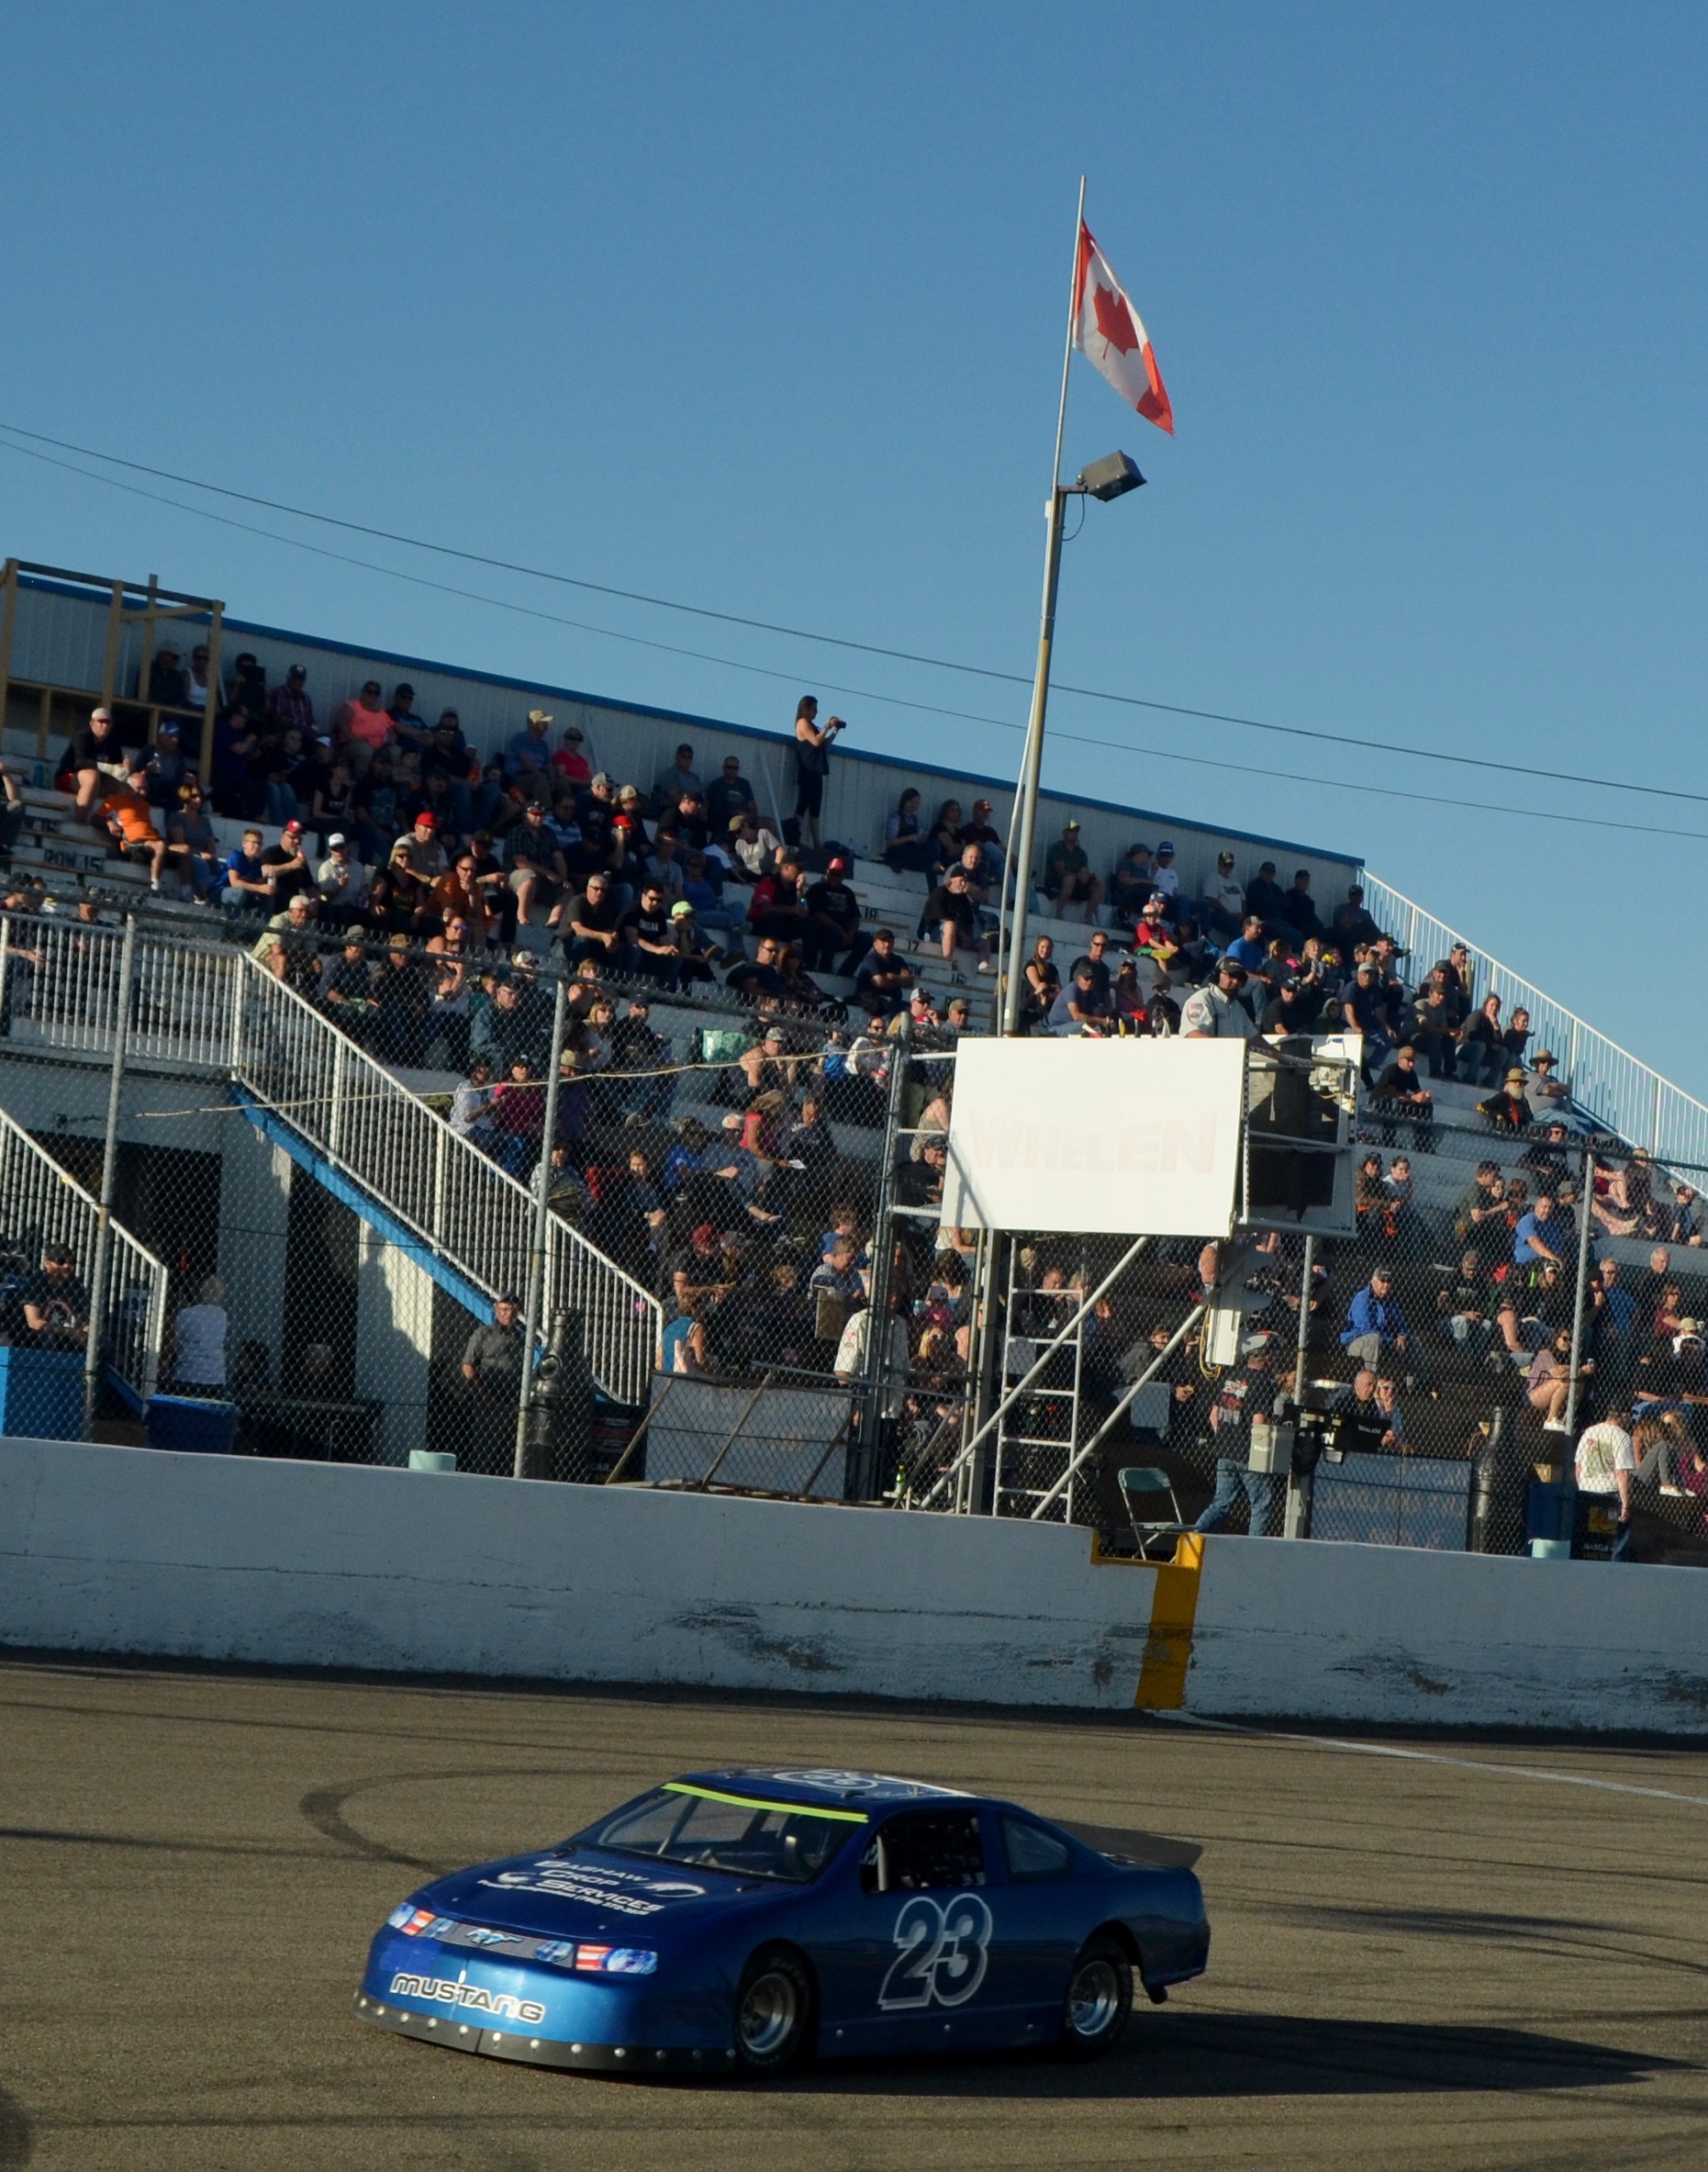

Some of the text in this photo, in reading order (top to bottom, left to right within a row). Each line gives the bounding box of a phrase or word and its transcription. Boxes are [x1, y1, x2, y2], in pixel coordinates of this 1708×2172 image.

[82, 855, 102, 872] 15
[908, 939, 921, 952] 17
[968, 1107, 1218, 1176] WHELEN
[533, 1860, 650, 1882] BASHAW
[540, 1869, 620, 1887] CROP
[536, 1879, 665, 1912] SERVICES
[876, 1893, 993, 2010] 23
[389, 1973, 546, 2024] MUSTANG
